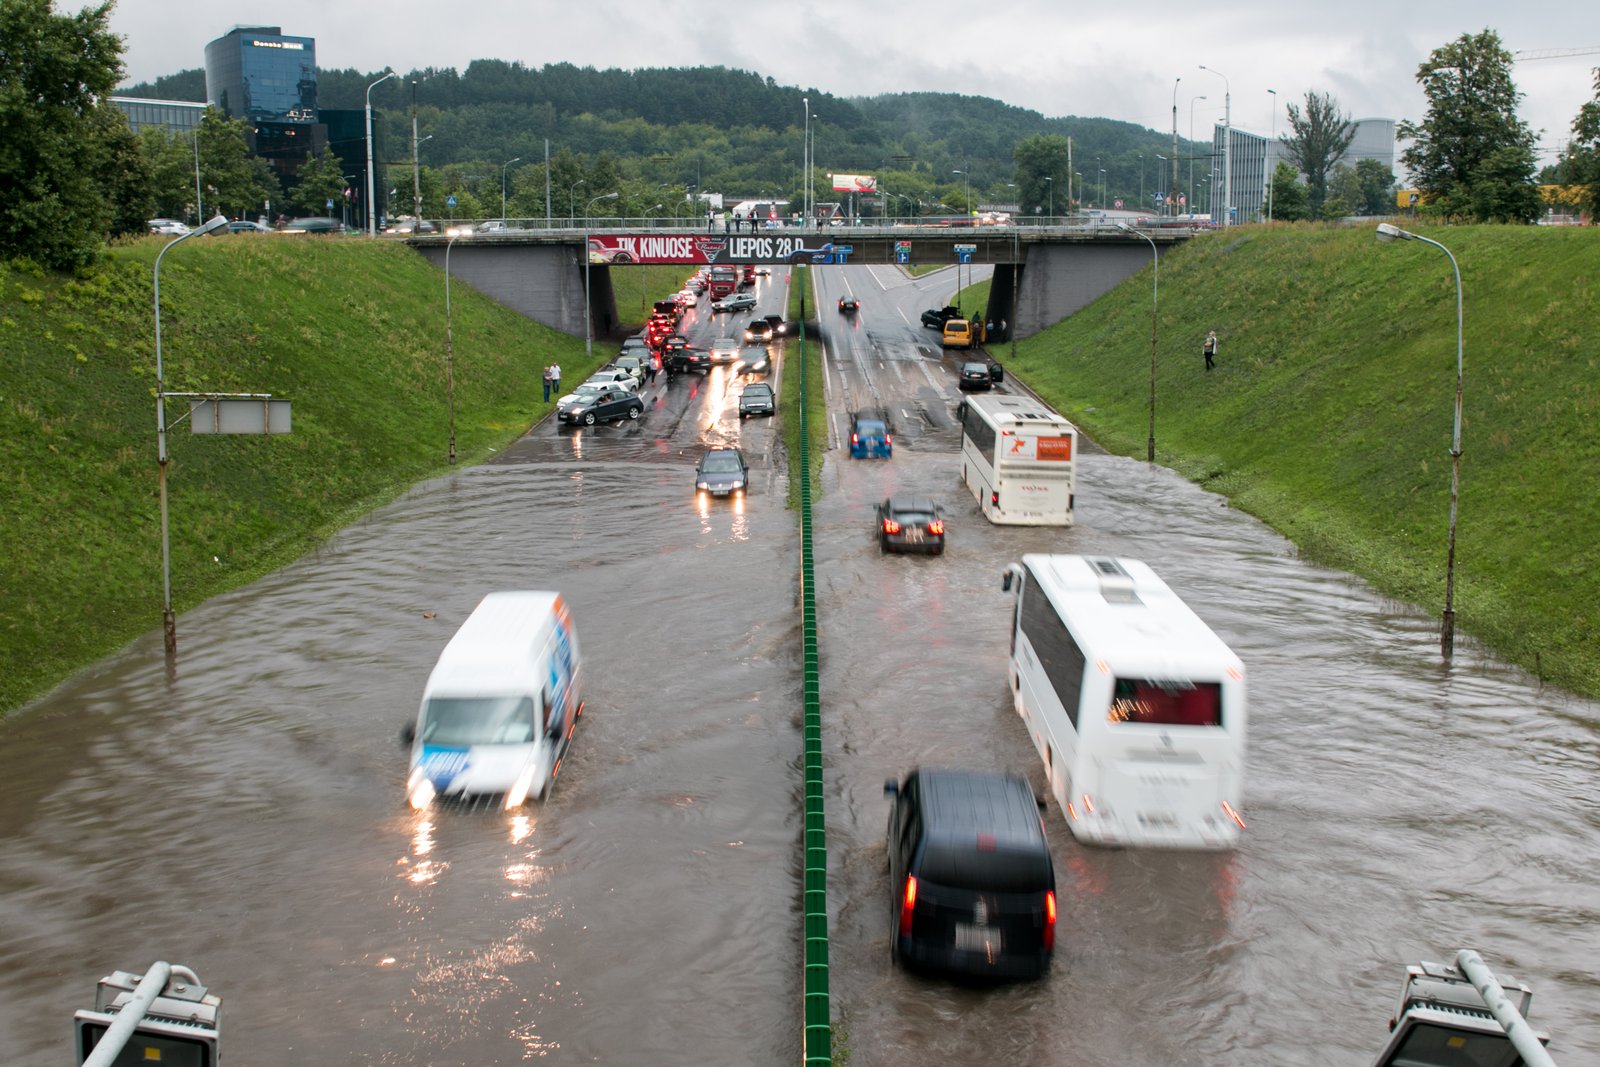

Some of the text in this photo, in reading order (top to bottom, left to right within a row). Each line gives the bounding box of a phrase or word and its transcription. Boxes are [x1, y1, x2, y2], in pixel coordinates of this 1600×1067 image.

[616, 237, 694, 258] TIK KINUOSE
[729, 237, 773, 258] LIEPOS
[775, 237, 792, 258] 28
